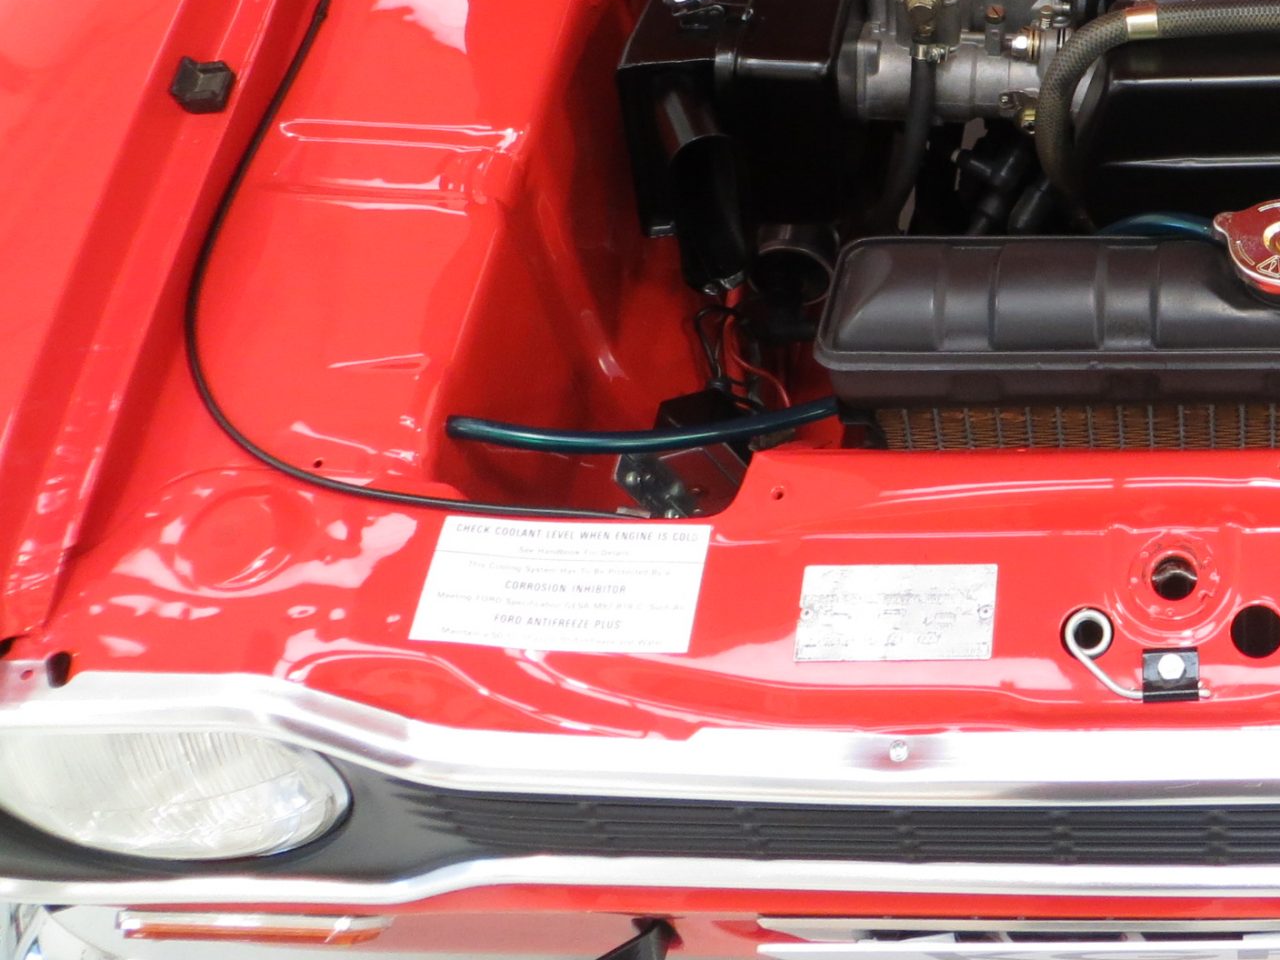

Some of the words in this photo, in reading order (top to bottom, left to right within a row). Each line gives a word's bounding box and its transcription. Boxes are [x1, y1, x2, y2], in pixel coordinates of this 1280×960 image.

[456, 523, 490, 534] CHECK
[495, 526, 541, 538] COOLANT
[546, 530, 574, 540] LEVEL
[580, 531, 609, 540] WHEN
[615, 531, 652, 541] ENGINE
[658, 532, 668, 541] IS
[672, 532, 699, 542] COLD
[504, 580, 566, 592] CORROSION
[572, 584, 626, 594] INHIBITOR
[494, 613, 521, 625] FORD
[527, 617, 589, 629] ANTIFREEZE
[594, 619, 621, 630] PLUS
